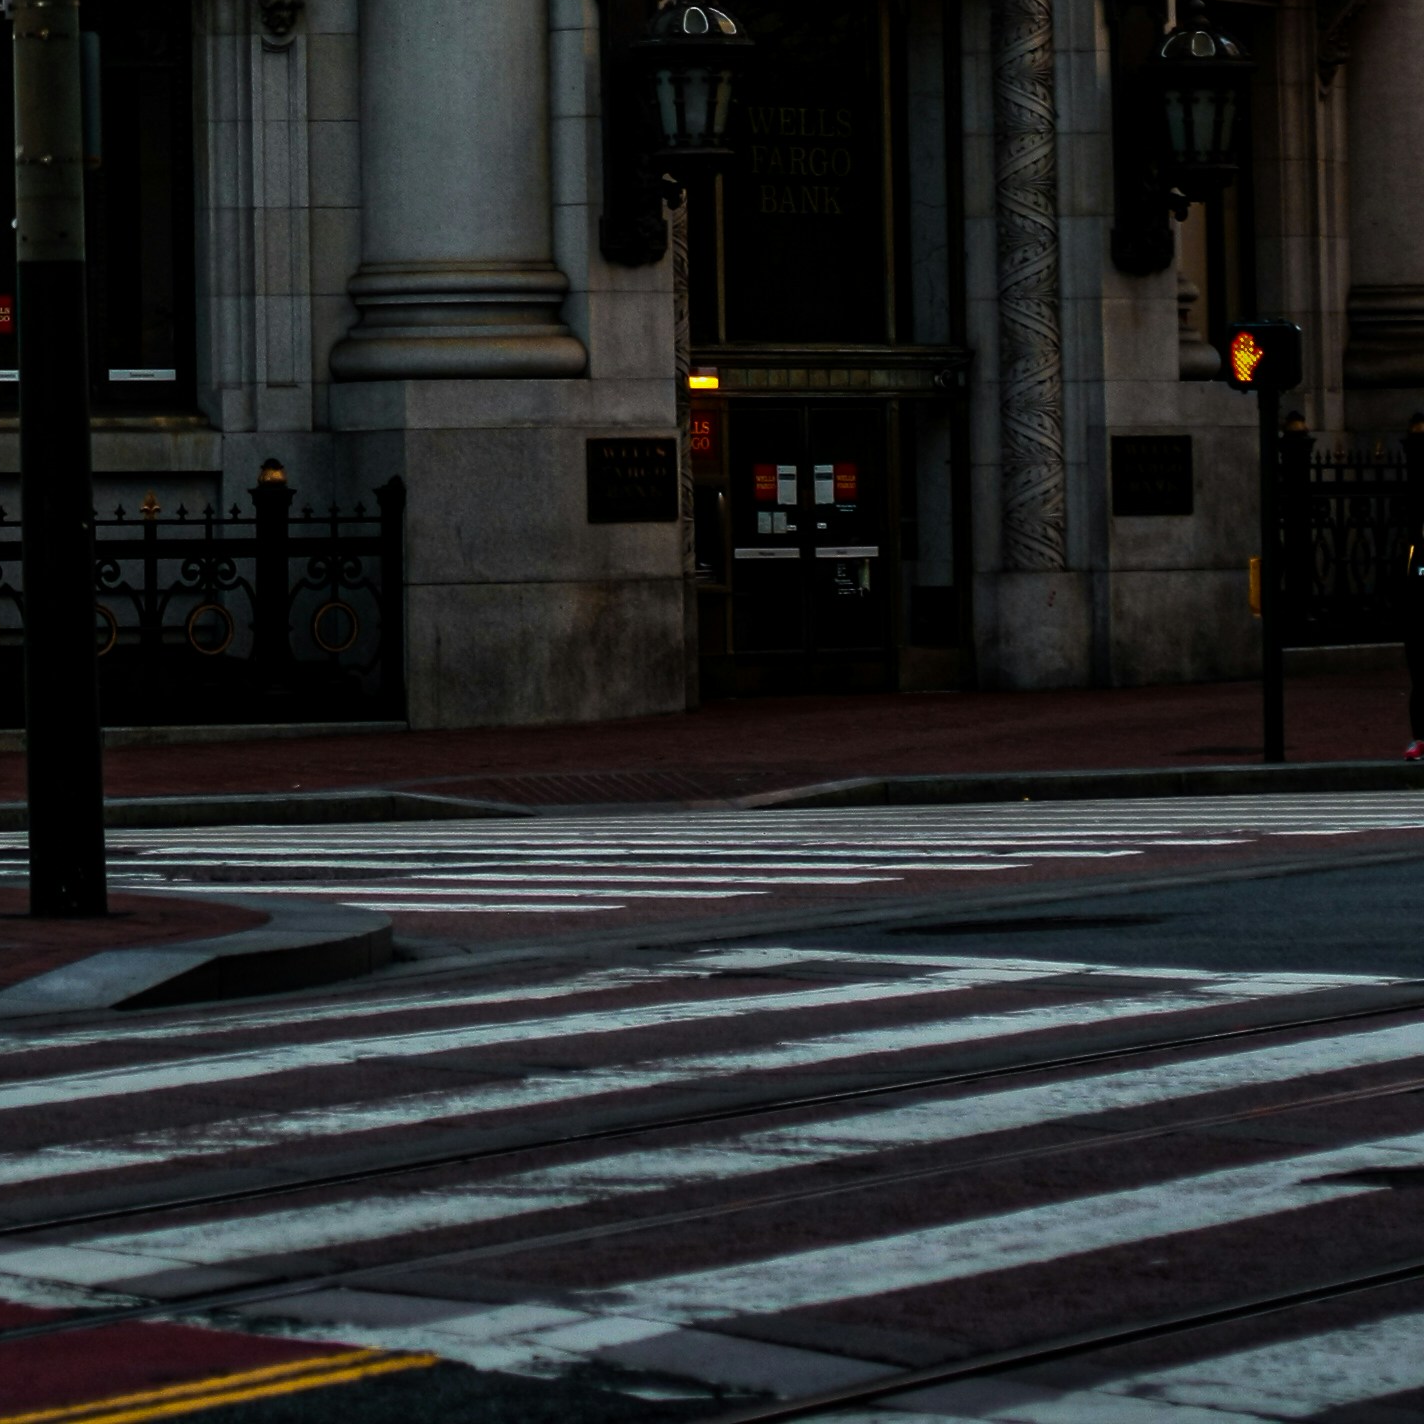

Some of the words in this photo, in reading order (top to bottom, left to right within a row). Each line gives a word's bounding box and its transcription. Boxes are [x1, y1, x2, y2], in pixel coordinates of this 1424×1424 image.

[746, 106, 854, 138] WELLS
[750, 144, 853, 177] FARGO
[759, 184, 844, 215] BANK
